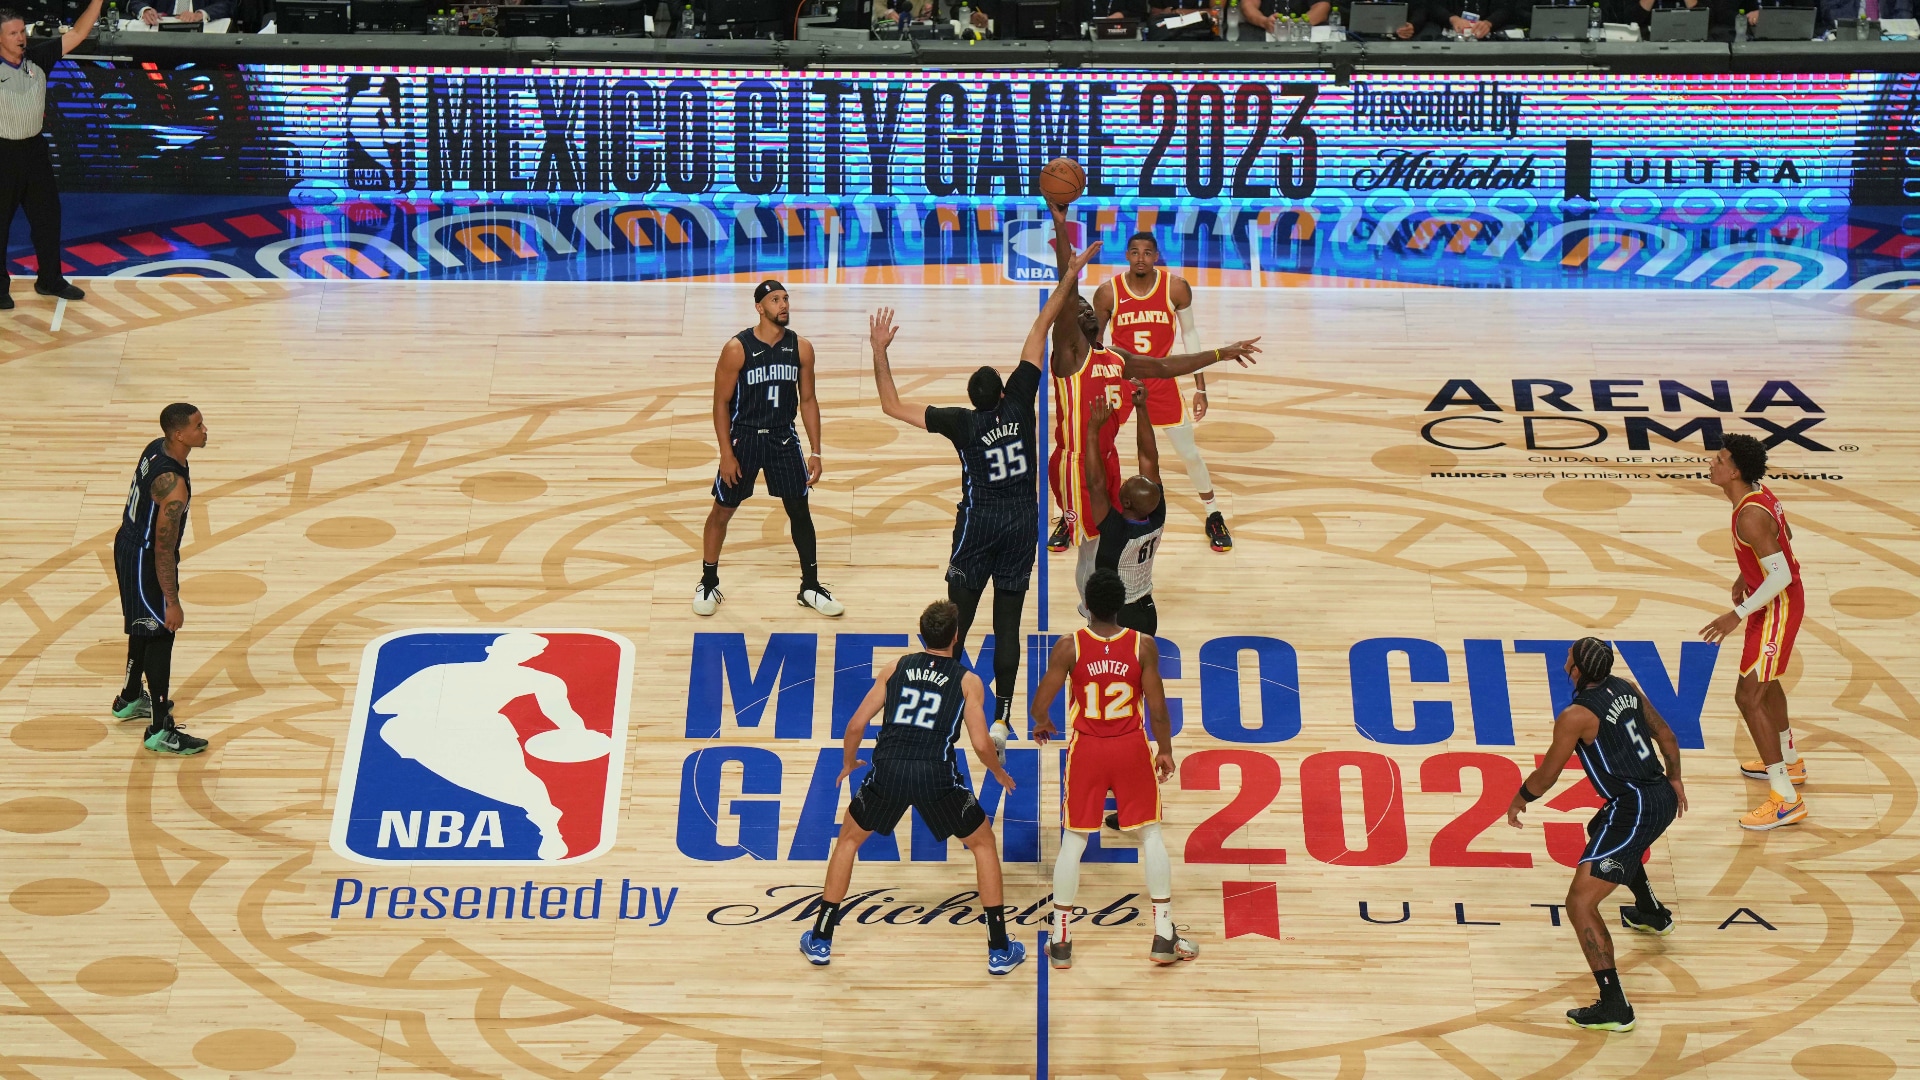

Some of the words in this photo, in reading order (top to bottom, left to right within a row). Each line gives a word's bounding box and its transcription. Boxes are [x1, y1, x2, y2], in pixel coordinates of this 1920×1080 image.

[1354, 81, 1485, 132] Presented
[1491, 81, 1524, 140] by
[427, 77, 713, 193] MEXICO
[734, 80, 908, 195] CITY
[924, 81, 1117, 197] GAME
[1138, 82, 1319, 199] 2023
[1624, 159, 1802, 185] ULTRA
[1016, 267, 1055, 279] NBA
[1117, 310, 1169, 326] ATLANTA
[1133, 331, 1152, 353] 5
[747, 364, 798, 385] ORLANDO
[1091, 364, 1122, 379] ATANT
[767, 385, 779, 408] 4
[1104, 384, 1123, 410] 15
[1424, 378, 1826, 413] ARENA
[981, 421, 1020, 446] BITADZE
[984, 440, 1028, 483] 35
[1651, 455, 1713, 463] MÉXIC
[1512, 471, 1555, 479] será
[1561, 471, 1578, 479] lo
[1768, 472, 1844, 481] vivirlo
[906, 667, 950, 687] WAGNER
[1087, 659, 1130, 677] HUNTER
[893, 686, 942, 729] 22
[1084, 681, 1134, 720] 12
[1605, 694, 1638, 725] BANCHERO
[1624, 717, 1650, 760] 5
[376, 810, 505, 849] NBA
[330, 878, 602, 921] Presented
[620, 878, 679, 928] by
[1358, 901, 1778, 931] ULTA
